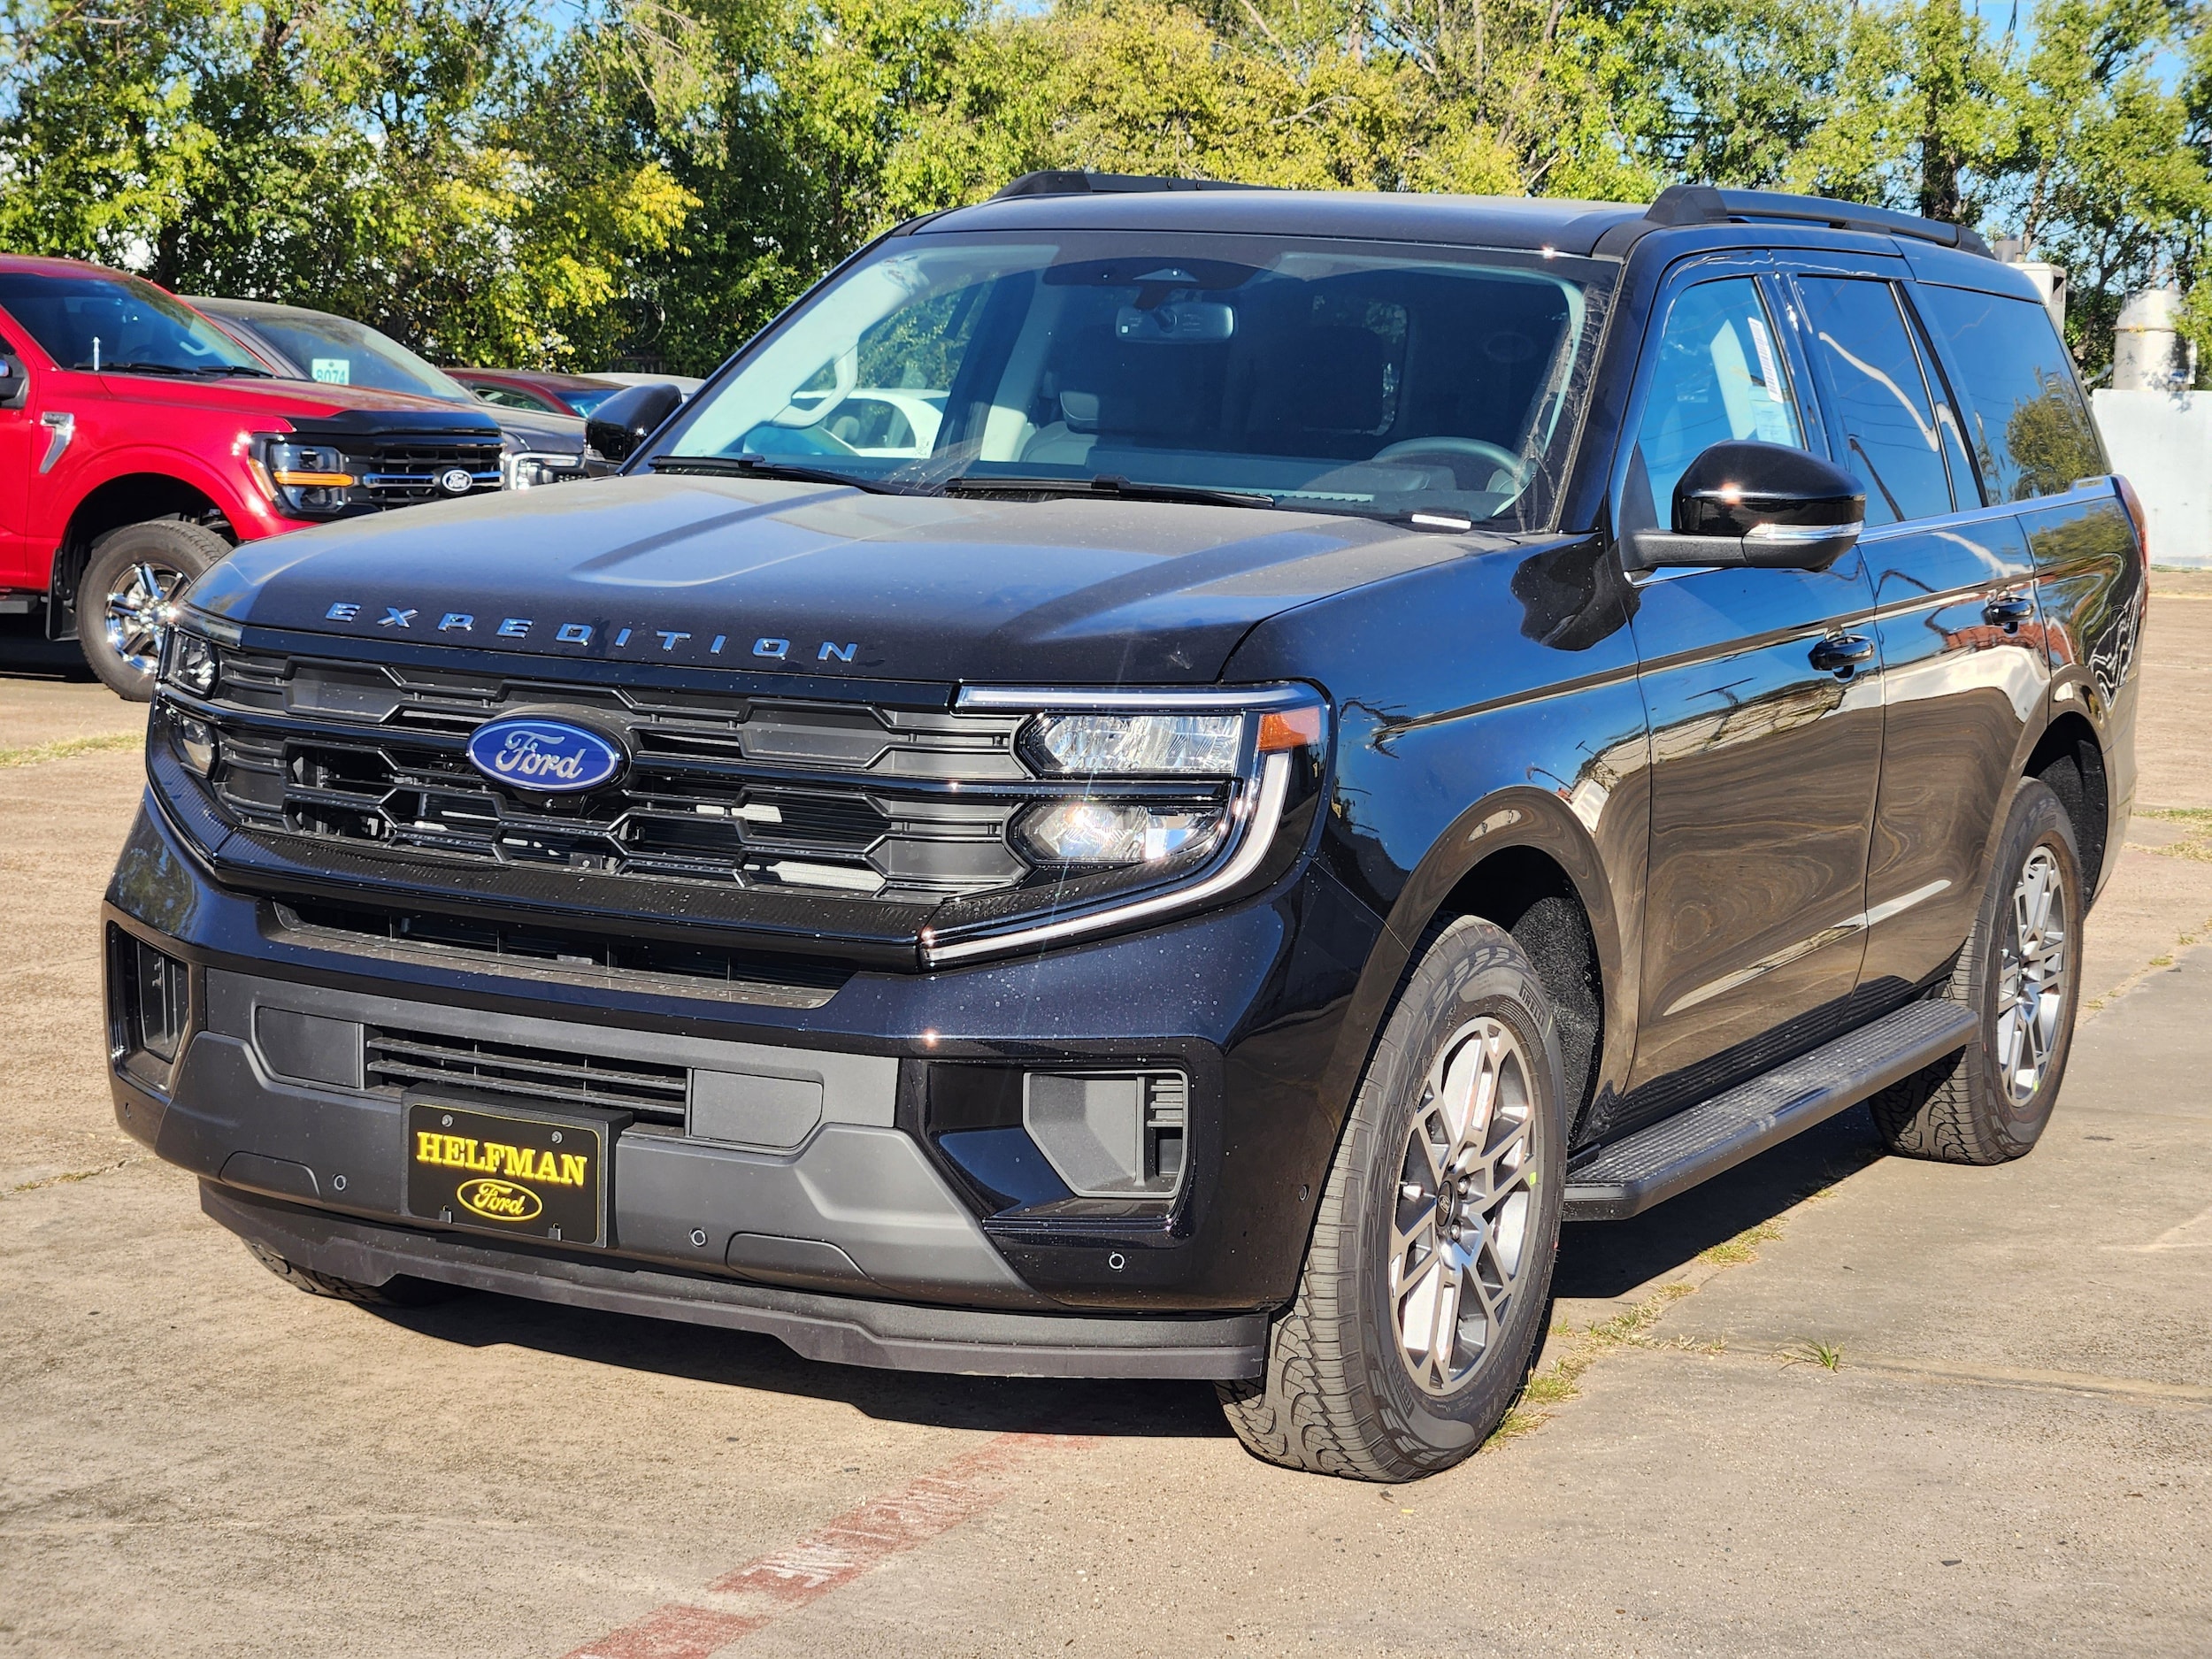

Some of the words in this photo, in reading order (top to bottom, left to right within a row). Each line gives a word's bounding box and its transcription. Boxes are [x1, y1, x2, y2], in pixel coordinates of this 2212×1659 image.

[317, 369, 346, 384] 8074
[325, 602, 860, 664] EXPEDITION
[495, 730, 584, 780] Ford
[416, 1132, 588, 1187] HELFMAN
[472, 1182, 526, 1216] Ford
